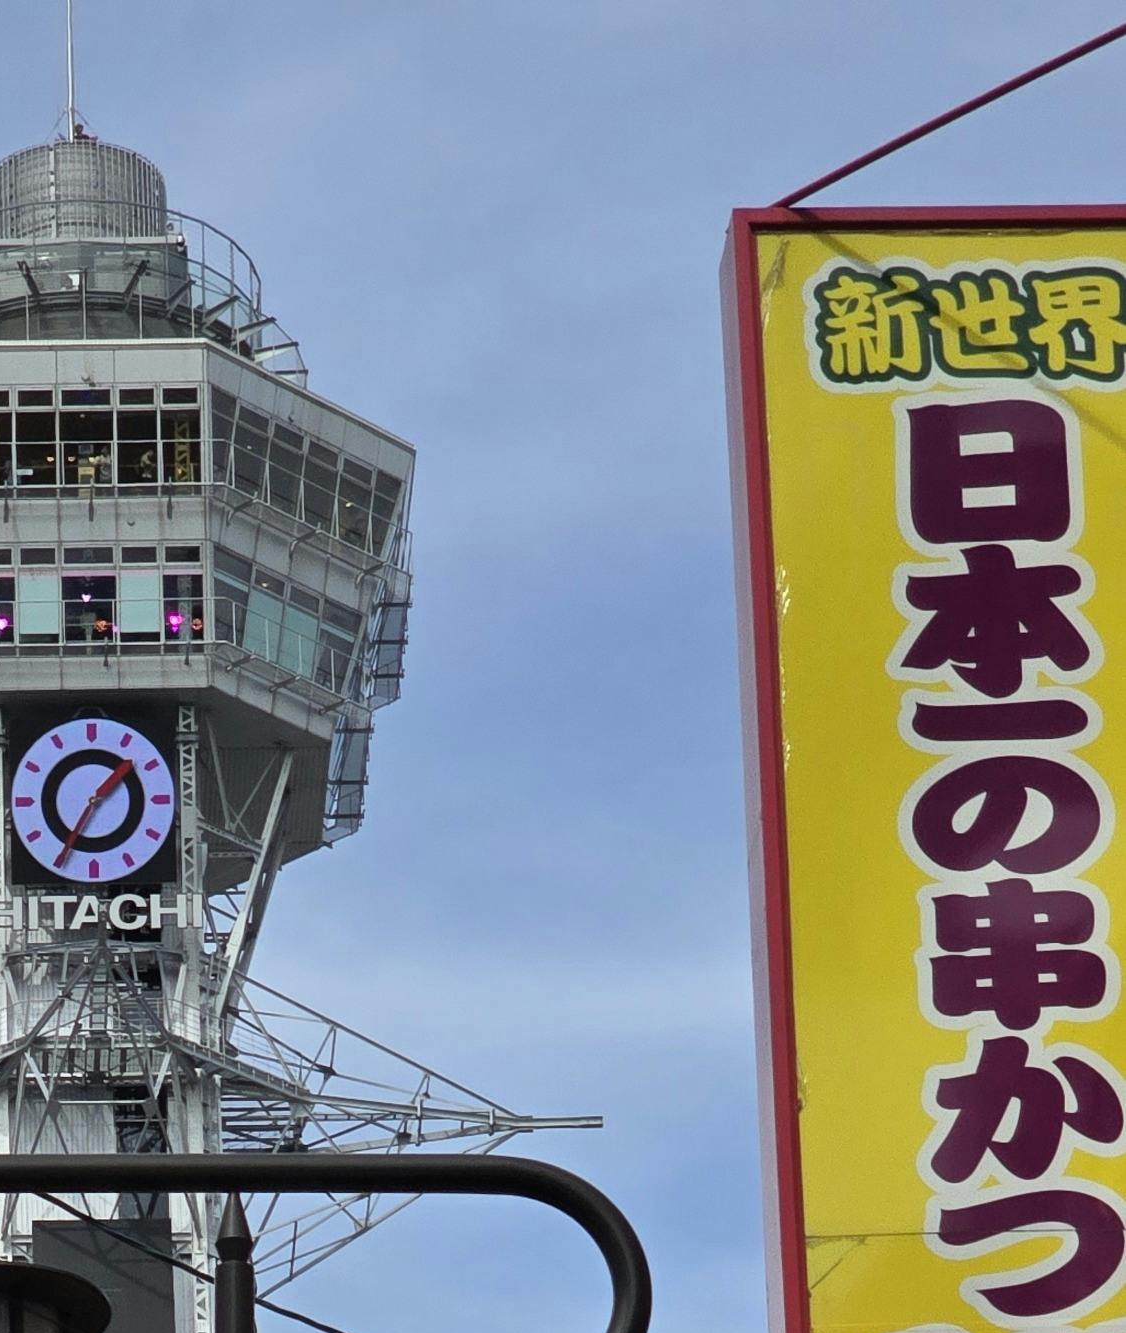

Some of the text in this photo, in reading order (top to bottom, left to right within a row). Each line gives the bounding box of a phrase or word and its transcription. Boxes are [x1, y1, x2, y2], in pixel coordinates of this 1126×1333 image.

[814, 266, 1126, 384] 新世界
[902, 400, 1126, 1317] 日本一の串かつ
